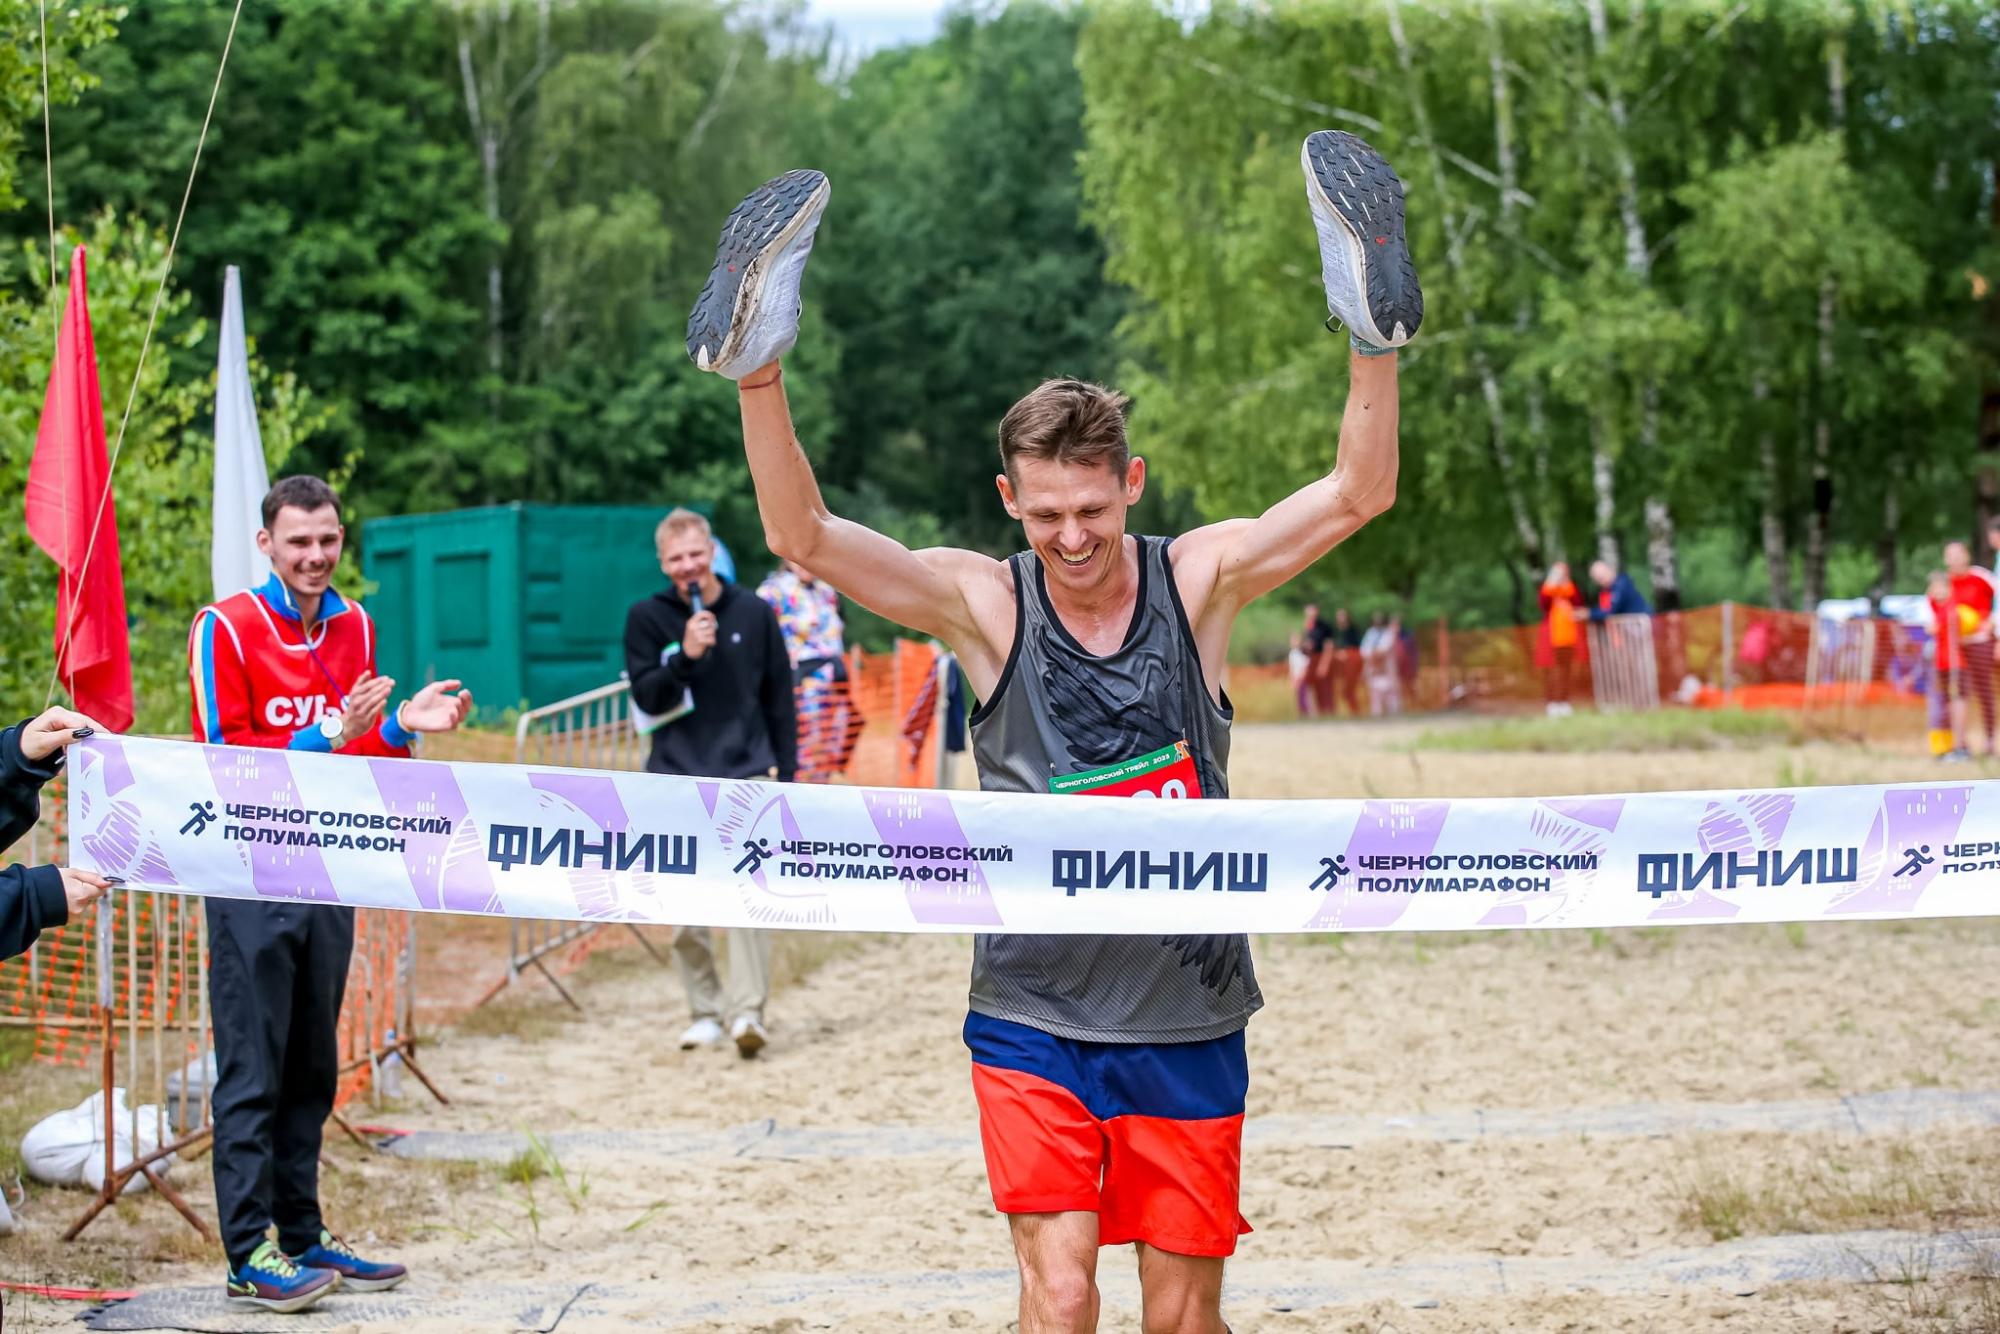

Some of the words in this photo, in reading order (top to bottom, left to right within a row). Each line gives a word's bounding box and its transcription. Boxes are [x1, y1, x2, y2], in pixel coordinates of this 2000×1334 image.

[1056, 768, 1125, 789] ЧЕРНОГОЛОВСКИЙ
[1125, 761, 1149, 774] ТРЕЙЛ
[225, 803, 452, 835] ЧЕРНОГОЛОВСКИЙ
[223, 825, 406, 853] ПОЛУМАРАФОН
[487, 823, 697, 875] ФИНИШ
[780, 840, 1013, 862] ЧЕРНОГОЛОВСКИЙ
[780, 861, 969, 883] ПОЛУМАРАФОН
[1052, 849, 1268, 897] ФИНИШ
[1358, 851, 1598, 871] ЧЕРНОГОЛОВСКИЙ
[1637, 847, 1858, 899] ФИНИШ
[1358, 877, 1551, 894] ПОЛУМАРАФОН
